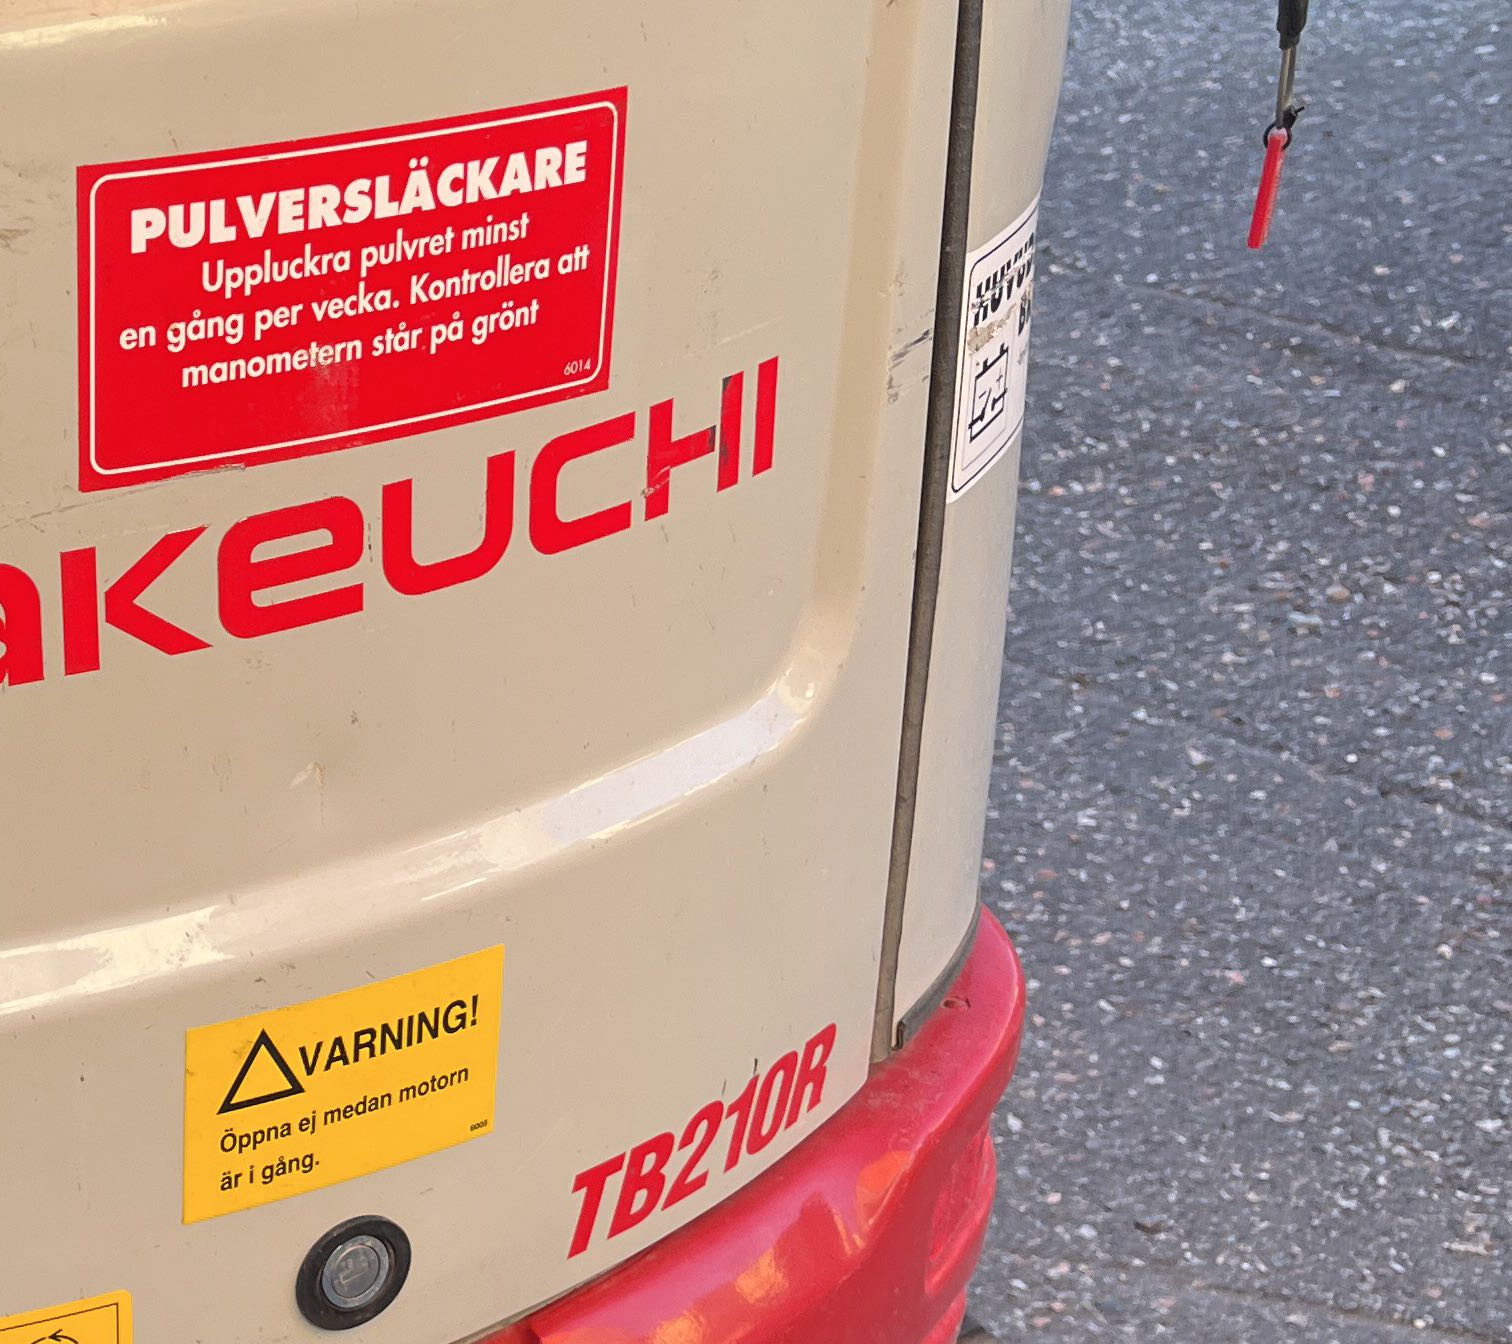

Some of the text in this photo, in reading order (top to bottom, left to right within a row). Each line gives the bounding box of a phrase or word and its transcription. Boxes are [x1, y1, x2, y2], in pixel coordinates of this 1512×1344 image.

[130, 141, 588, 254] PULVERSLÄCKARE
[119, 243, 590, 353] en gång per vecka. Kontrollera att
[201, 212, 531, 299] Uppluckra pulvret minst
[181, 298, 540, 389] manometern står på grönt
[562, 357, 592, 378] 6014
[298, 993, 479, 1077] VARNING!
[220, 1067, 469, 1154] Öppna ej medan motorn
[567, 1022, 837, 1260] TB210R
[220, 1152, 320, 1191] är i gång.
